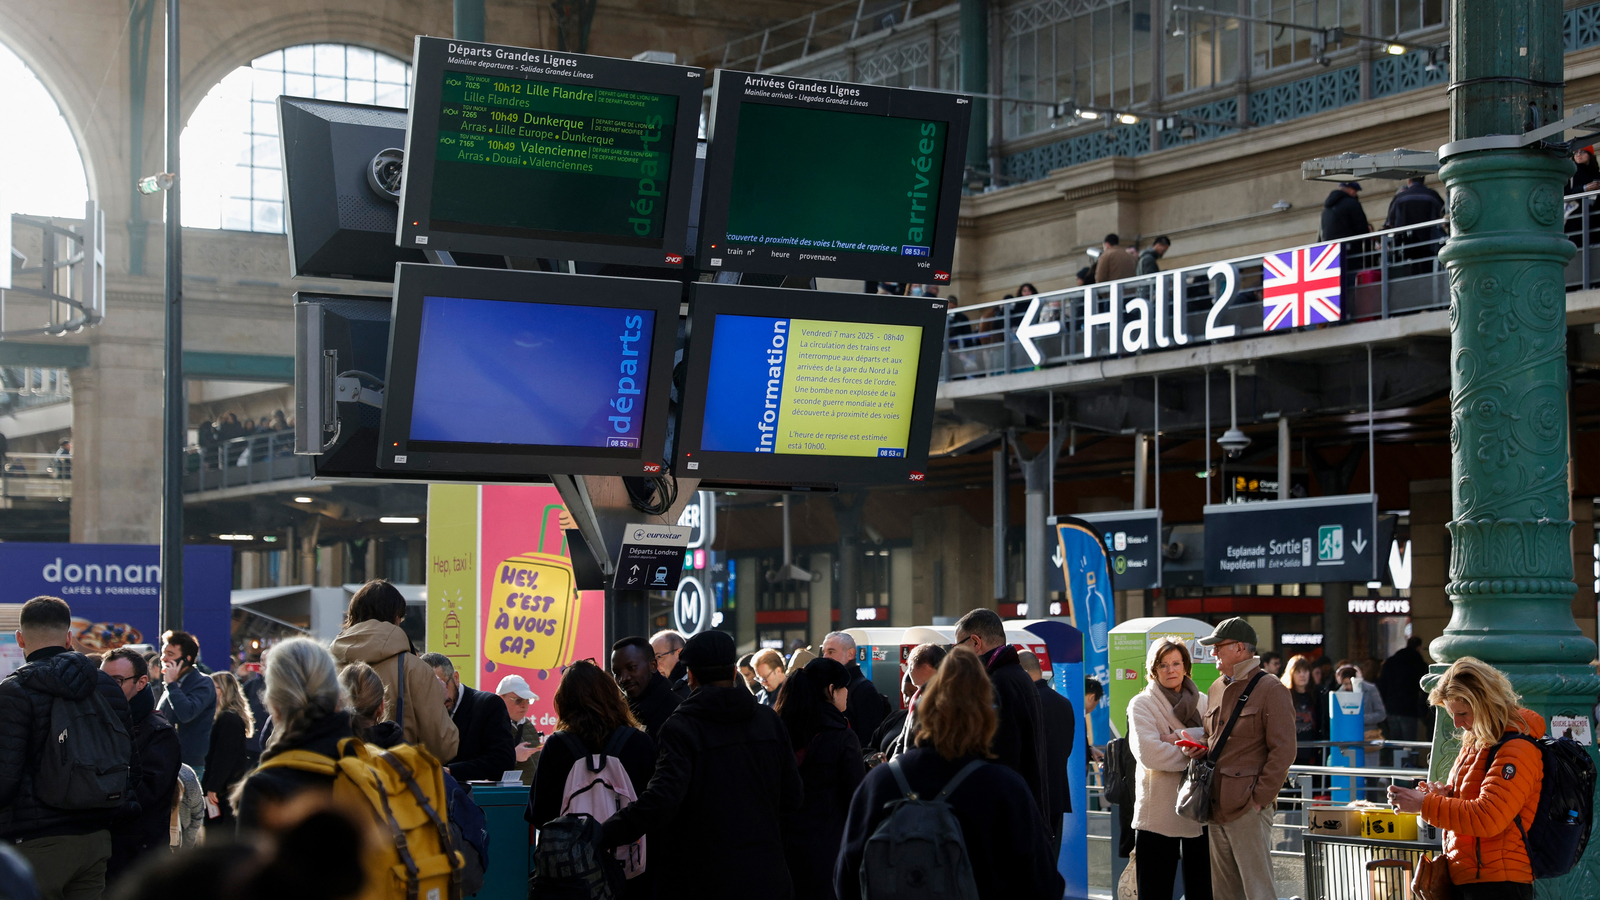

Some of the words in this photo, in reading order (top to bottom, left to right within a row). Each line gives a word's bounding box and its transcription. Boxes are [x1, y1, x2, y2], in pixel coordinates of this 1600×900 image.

[448, 44, 492, 58] Départs
[496, 49, 540, 62] Grandes
[543, 54, 577, 67] Lignes
[448, 57, 476, 66] Mainline
[478, 60, 514, 70] departures
[520, 65, 543, 73] Salidas
[545, 68, 571, 77] Grandes
[573, 70, 594, 79] Líneas
[493, 82, 521, 93] 10h12
[527, 84, 549, 96] Lille
[552, 86, 594, 101] Flandre
[745, 76, 784, 88] Arrivées
[788, 81, 827, 93] Grandes
[830, 84, 860, 97] Lignes
[464, 91, 485, 103] Lille
[488, 94, 530, 108] Flandres
[744, 89, 770, 97] Mainline
[799, 94, 824, 102] Llegadas
[826, 97, 848, 105] Grandes
[491, 112, 518, 122] 10h49
[524, 113, 584, 130] Dunkerque
[461, 121, 487, 133] Arras
[495, 124, 516, 135] Lille
[519, 127, 553, 140] Europe
[562, 131, 614, 146] Dunkerque
[488, 140, 515, 151] 10h49
[521, 142, 587, 158] Valencienne
[458, 150, 484, 161] Arras
[492, 153, 521, 164] Douai
[530, 156, 593, 172] Valenciennes
[628, 114, 663, 236] départs
[907, 122, 936, 242] arrivées
[764, 236, 798, 245] proximité
[813, 239, 830, 247] voies
[832, 240, 856, 249] L'heure
[867, 244, 889, 252] reprise
[1084, 271, 1188, 358] Hall
[1205, 262, 1236, 340] 2
[802, 329, 832, 337] Vendredi
[799, 352, 840, 361] interrompue
[856, 355, 880, 363] départs
[608, 314, 642, 433] départs
[755, 320, 787, 453] information
[789, 431, 814, 439] L'heure
[1227, 546, 1265, 559] Esplanade
[1269, 539, 1300, 555] Sortie
[434, 556, 451, 577] Hep,
[453, 553, 467, 572] taxi
[686, 554, 692, 566] D
[1220, 559, 1256, 572] Napoléon
[62, 585, 91, 595] CAFÉS
[105, 587, 157, 595] PORRIDGES
[506, 592, 555, 613] C'EST
[681, 591, 697, 624] M
[1348, 600, 1376, 613] FIVE
[1376, 600, 1410, 613] GUYS
[494, 608, 509, 630] À
[514, 616, 557, 636] VOUS
[500, 636, 535, 659] ÇA?
